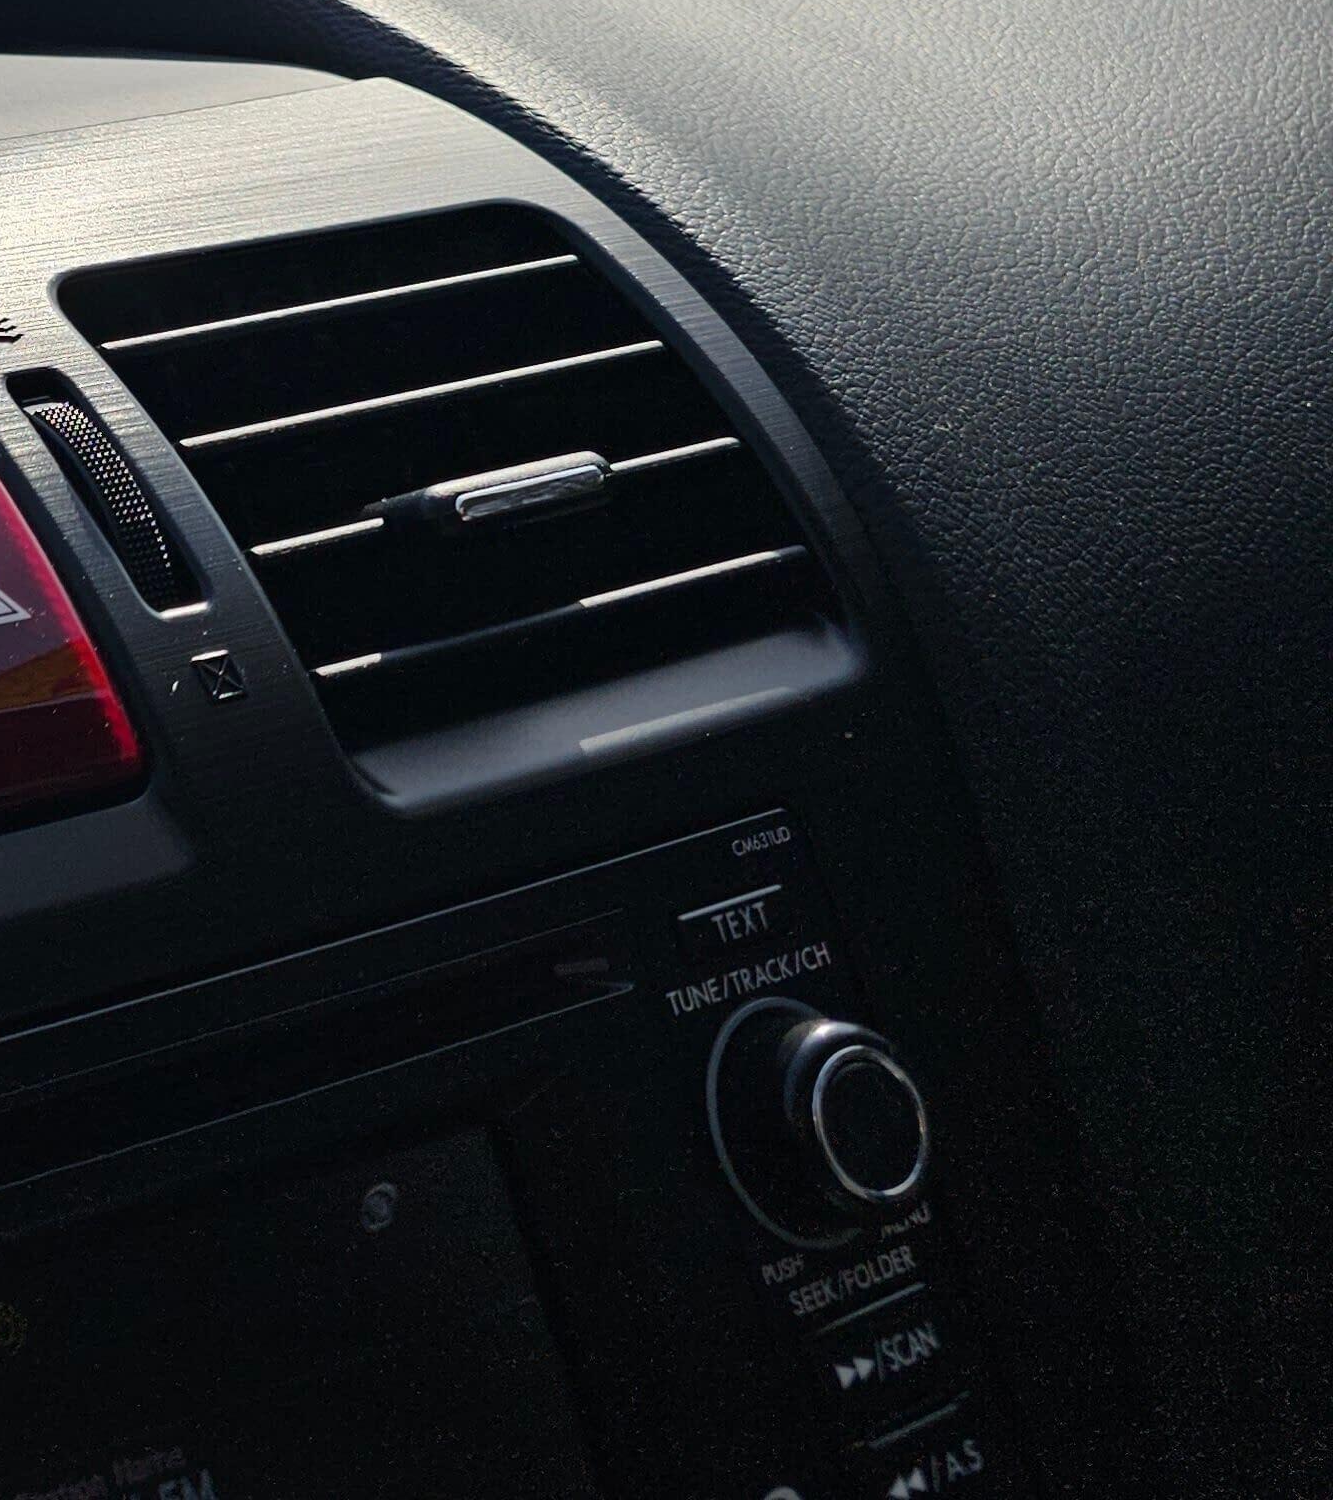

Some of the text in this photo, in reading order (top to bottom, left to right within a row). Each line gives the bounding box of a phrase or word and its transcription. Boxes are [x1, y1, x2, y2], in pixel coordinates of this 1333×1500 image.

[709, 900, 770, 944] TEXT
[664, 941, 833, 1018] TUNE/TRACK/CH
[761, 1252, 806, 1287] PUSH
[788, 1244, 918, 1317] SEEK/FOLDER
